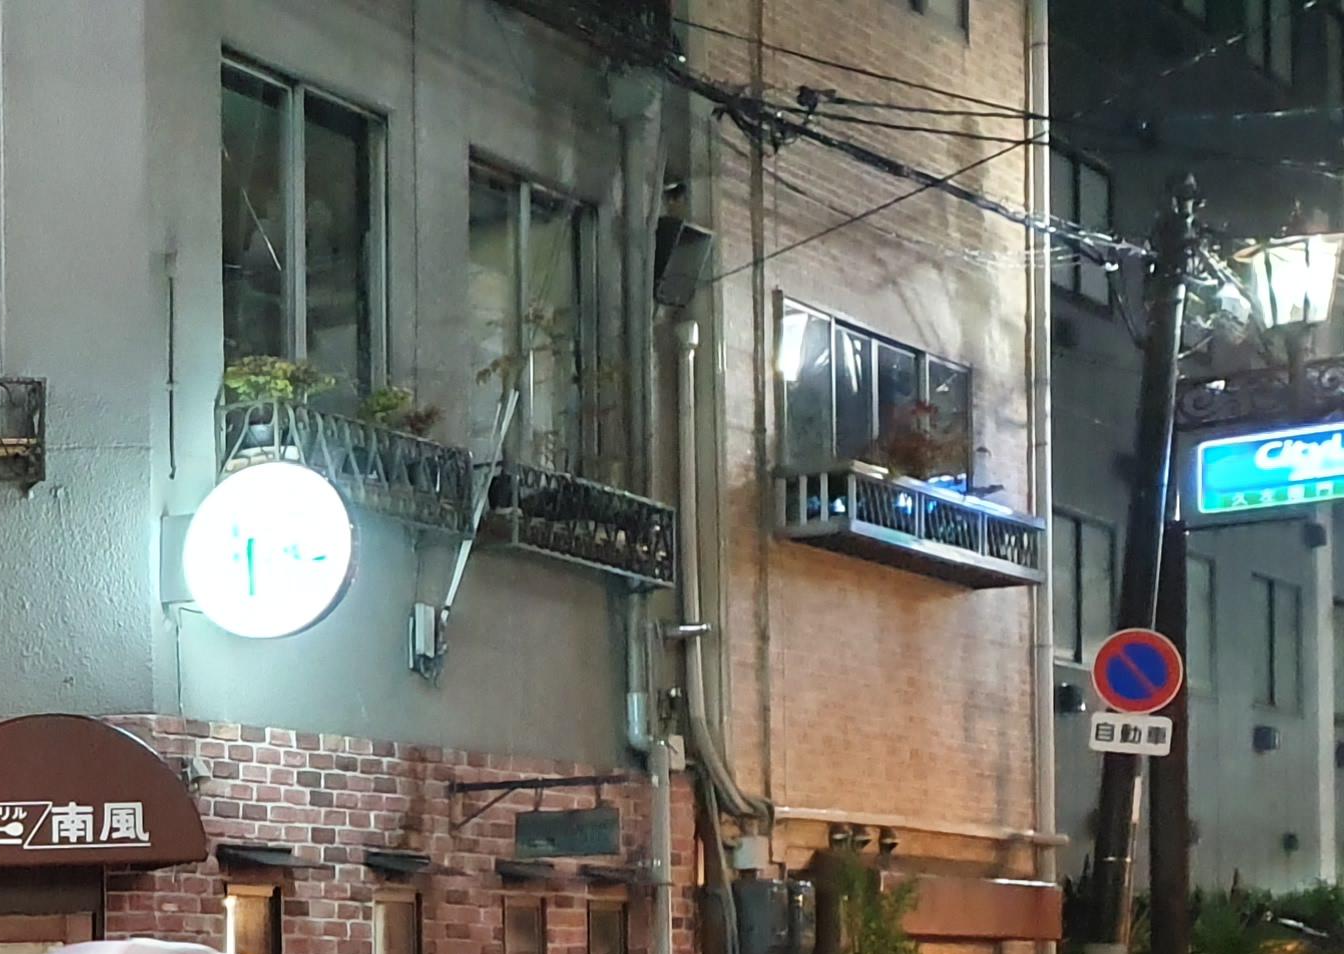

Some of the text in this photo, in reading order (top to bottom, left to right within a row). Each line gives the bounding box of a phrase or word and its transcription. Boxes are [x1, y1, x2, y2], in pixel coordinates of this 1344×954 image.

[1094, 721, 1168, 745] 自動車
[50, 801, 150, 843] 南風
